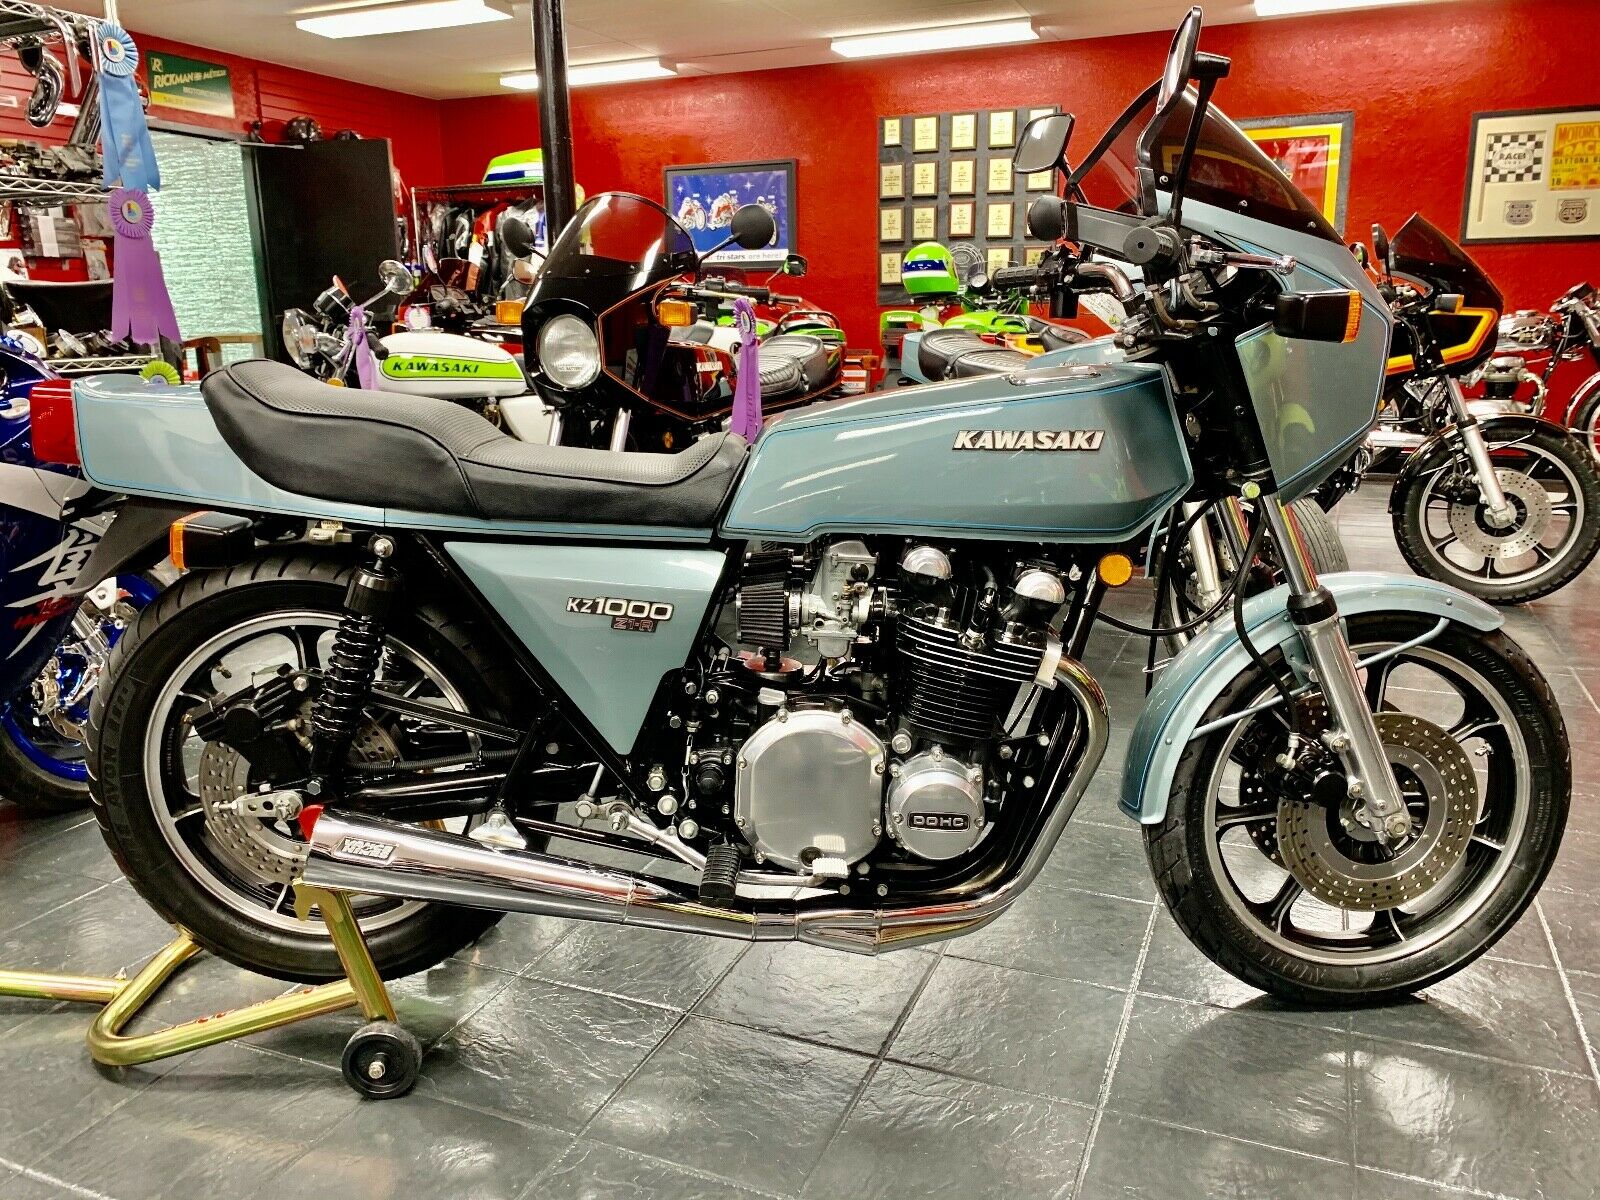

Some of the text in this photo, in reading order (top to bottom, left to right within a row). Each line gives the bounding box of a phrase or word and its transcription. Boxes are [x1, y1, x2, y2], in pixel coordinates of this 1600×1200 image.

[392, 362, 480, 374] KAWASAKI
[952, 430, 1105, 450] KAWASAKI
[566, 597, 674, 621] KZ1000
[913, 815, 964, 827] DOHC
